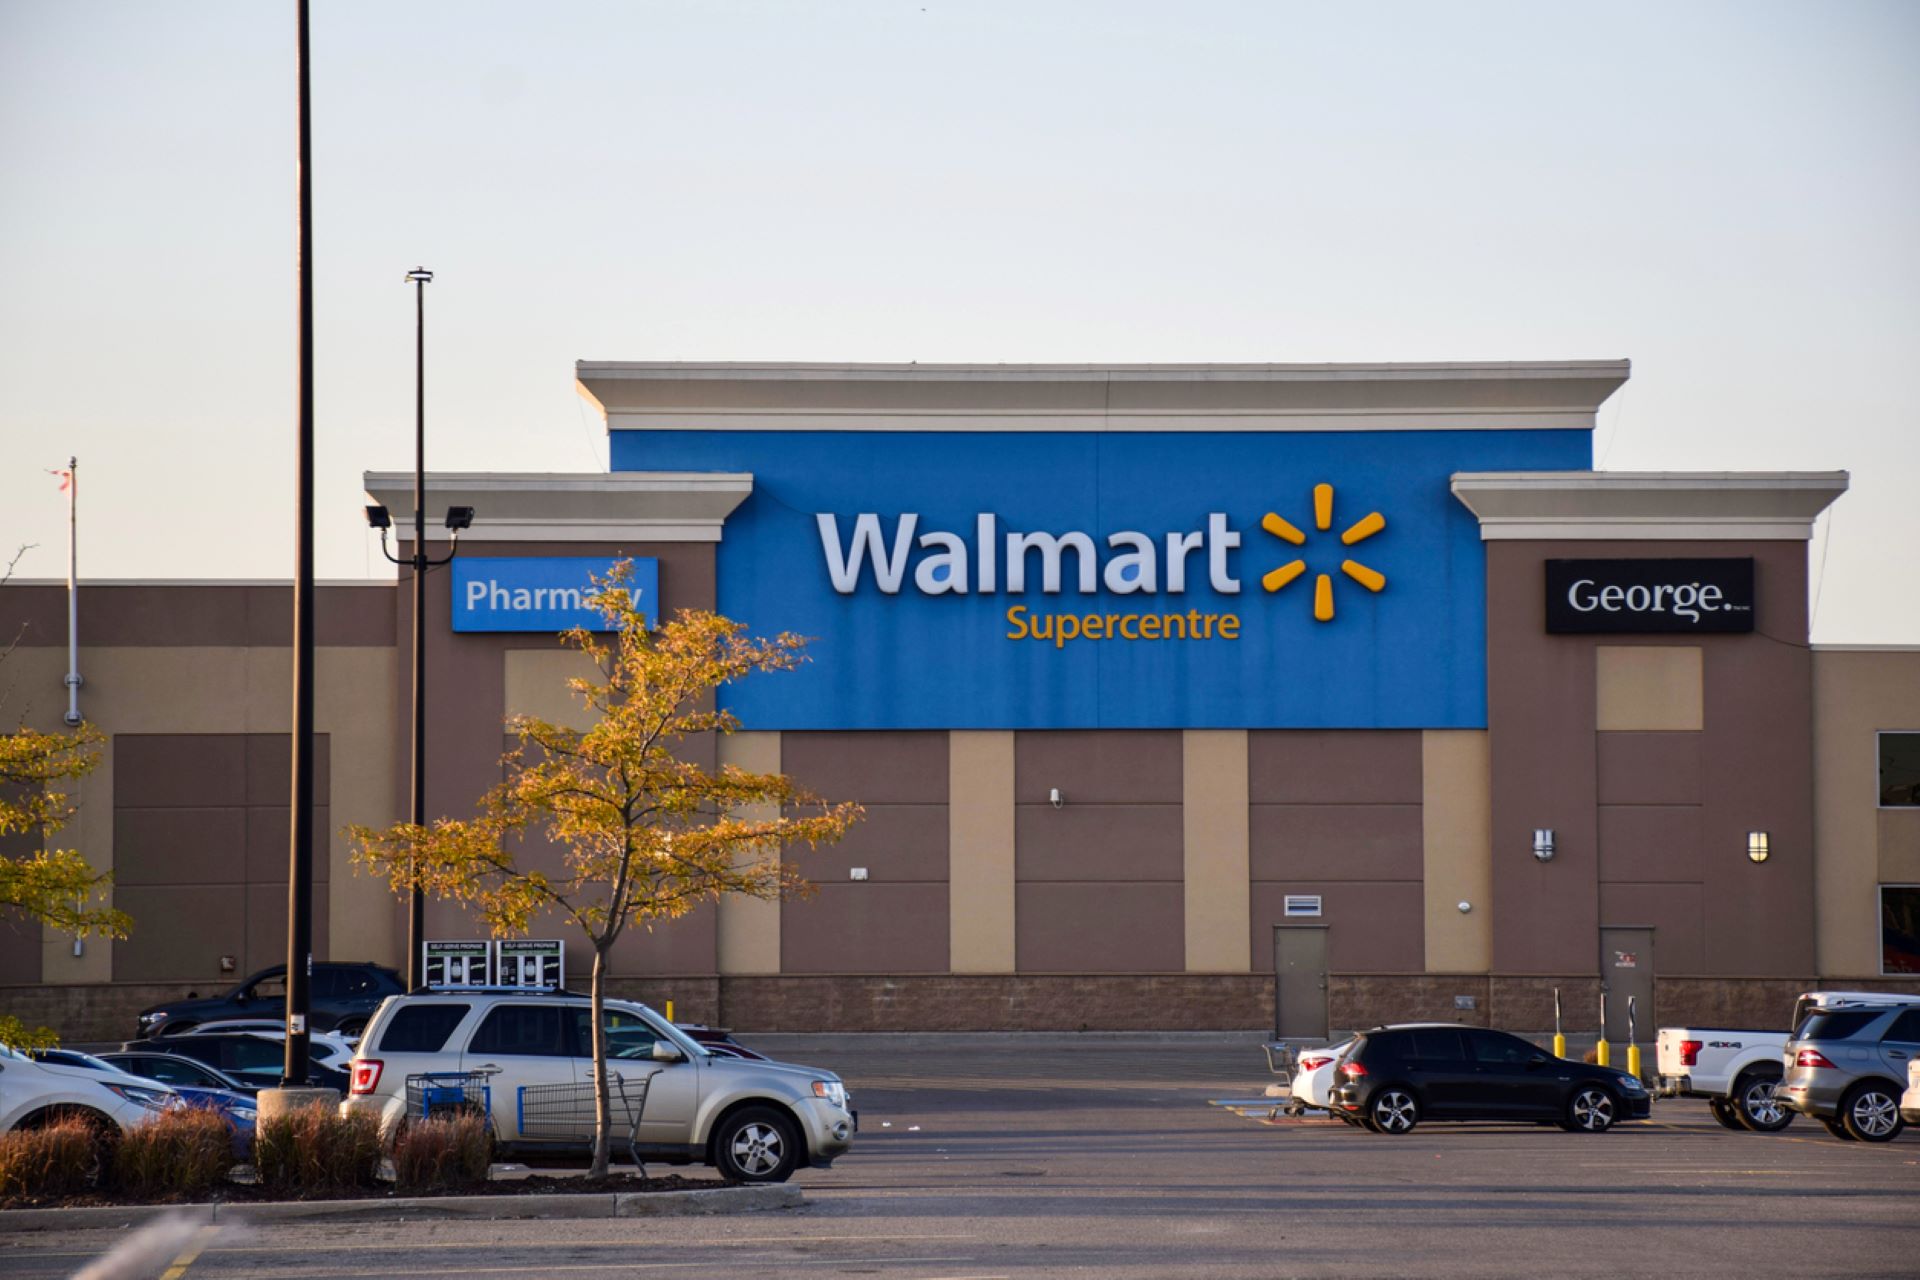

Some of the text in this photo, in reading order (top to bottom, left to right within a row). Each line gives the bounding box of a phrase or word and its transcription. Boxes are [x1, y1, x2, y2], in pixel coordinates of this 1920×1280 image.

[815, 512, 1241, 595] Walmart
[465, 579, 643, 614] Pharmay
[1006, 605, 1240, 648] Supercentre
